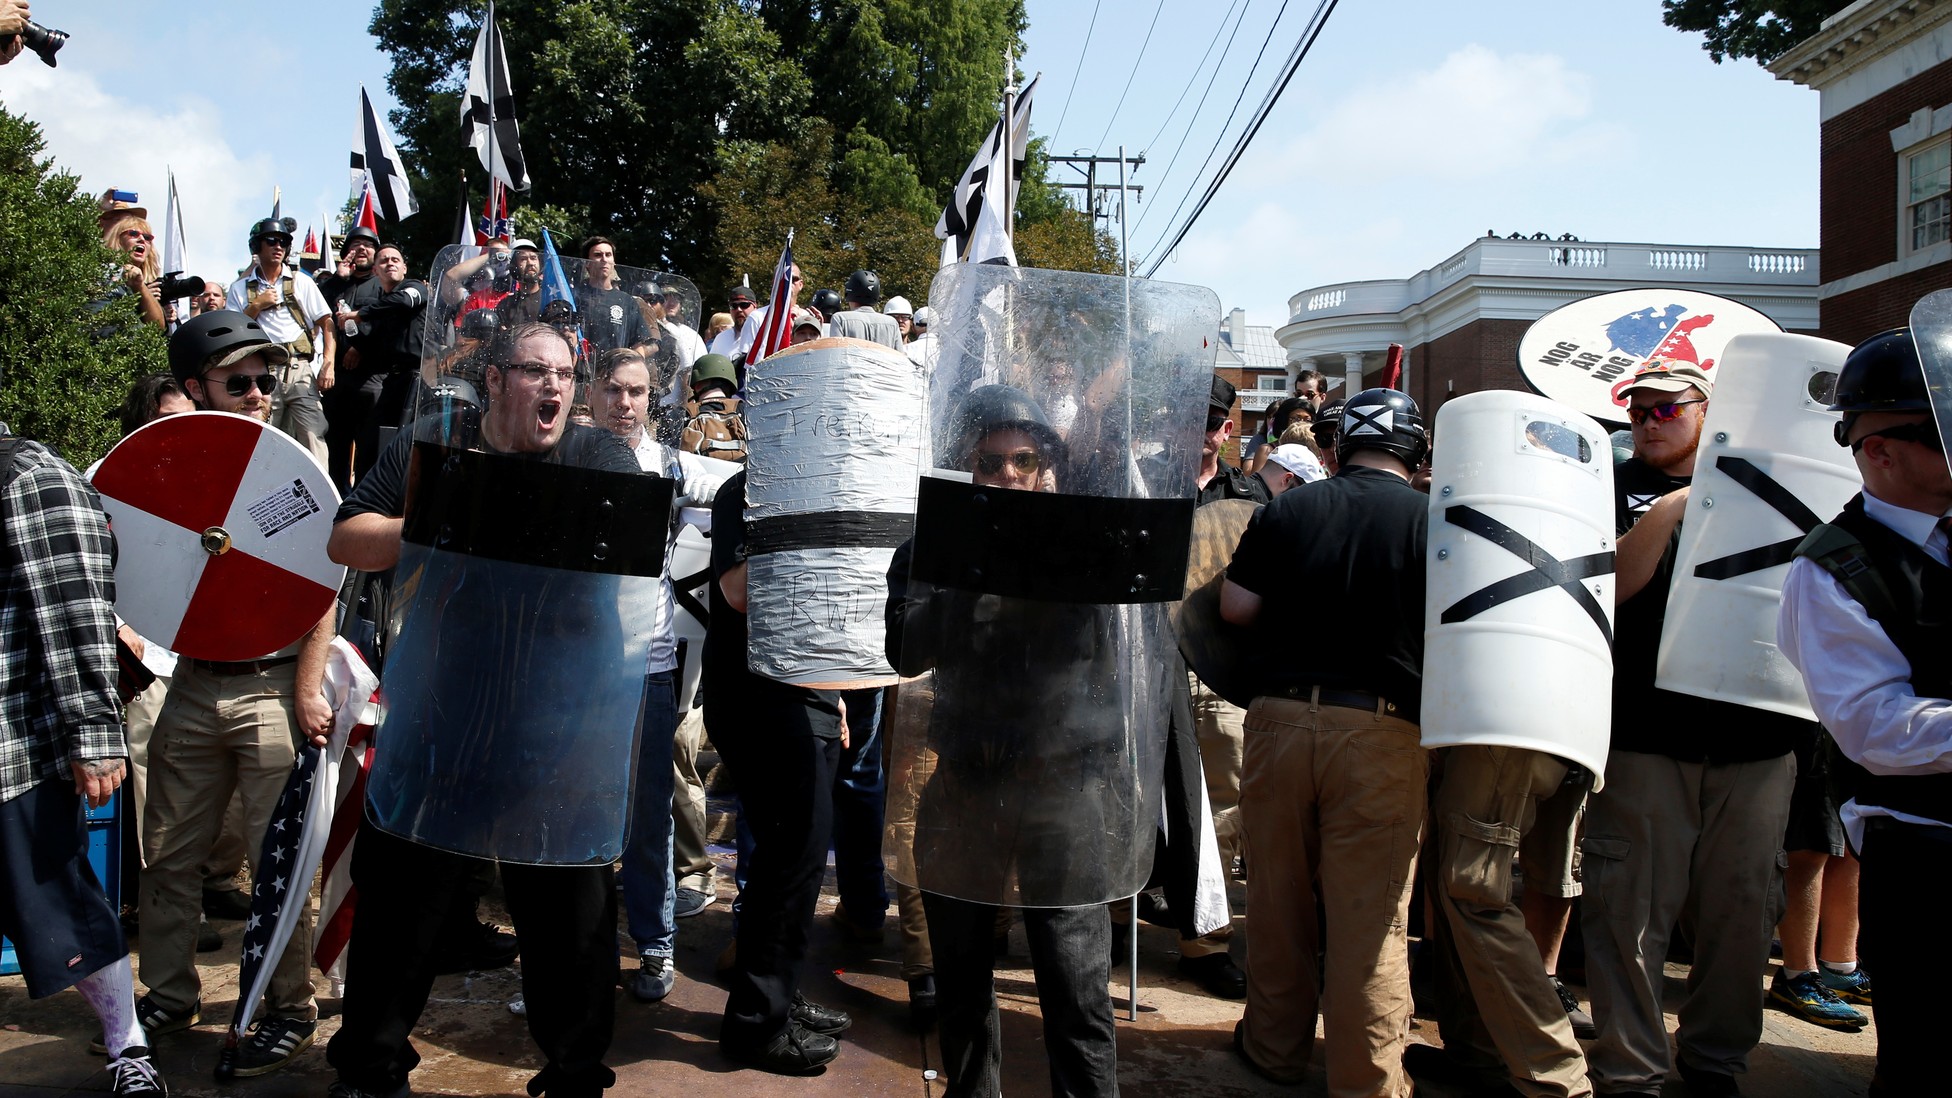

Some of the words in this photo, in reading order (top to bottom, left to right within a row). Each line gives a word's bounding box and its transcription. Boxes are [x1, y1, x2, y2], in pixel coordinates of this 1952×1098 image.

[1538, 341, 1580, 367] NOG
[1566, 352, 1603, 371] ÄR
[1591, 356, 1635, 383] NOG
[260, 525, 270, 533] FOR
[281, 513, 292, 522] AND
[291, 504, 308, 516] NATION
